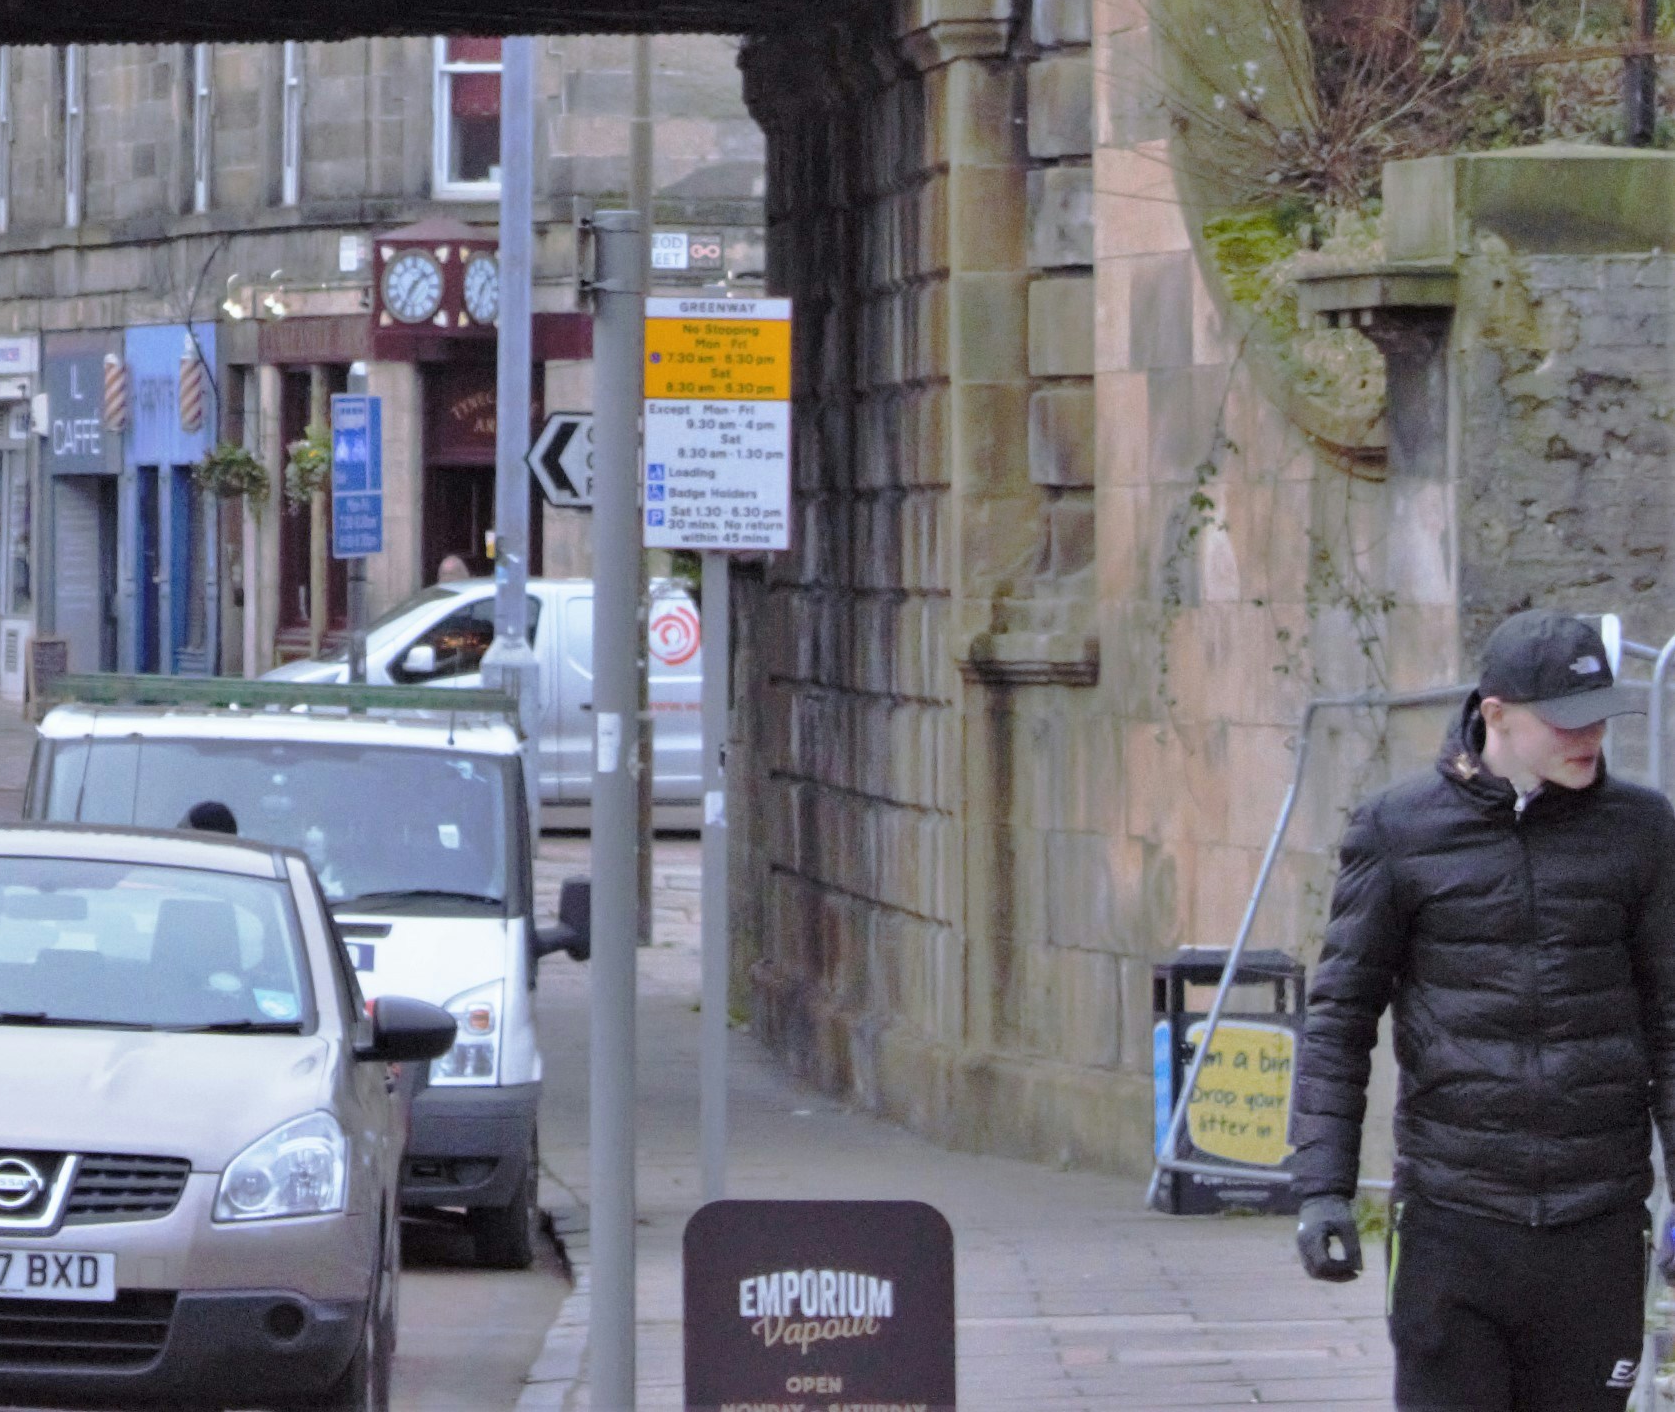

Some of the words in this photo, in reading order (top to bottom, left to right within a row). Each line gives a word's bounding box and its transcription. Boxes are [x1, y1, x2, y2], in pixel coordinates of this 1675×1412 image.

[679, 302, 757, 313] GREENWAY
[683, 324, 699, 335] No
[705, 324, 760, 337] Stopping
[695, 339, 720, 349] Mon
[731, 339, 747, 349] Fri
[697, 355, 714, 363] am
[756, 356, 775, 365] pm
[711, 368, 731, 379] Sat
[698, 384, 715, 392] am
[756, 385, 775, 394] pm
[650, 404, 690, 416] Except
[703, 405, 728, 414] Mon
[738, 404, 755, 415] Fri
[686, 419, 715, 429] 9.30
[718, 421, 736, 429] am
[745, 420, 753, 429] 4
[756, 421, 775, 431] pm
[720, 434, 741, 445] Sat
[709, 451, 727, 459] am
[737, 448, 762, 459] 1.30
[765, 451, 784, 460] pm
[669, 467, 716, 479] Loading
[669, 488, 706, 500] Badge
[710, 489, 758, 499] Holders
[671, 506, 691, 516] Sat
[696, 506, 722, 517] 1.30
[762, 509, 781, 519] pm
[667, 519, 685, 530] 30
[724, 520, 742, 530] No
[745, 521, 784, 530] return
[681, 533, 718, 543] within
[722, 533, 739, 543] 45
[742, 533, 770, 543] mins
[1233, 1052, 1248, 1069] a
[27, 1254, 99, 1289] BXD
[739, 1269, 894, 1317] EMPORIUM
[751, 1316, 881, 1355] Vapour
[785, 1376, 843, 1393] OPEN
